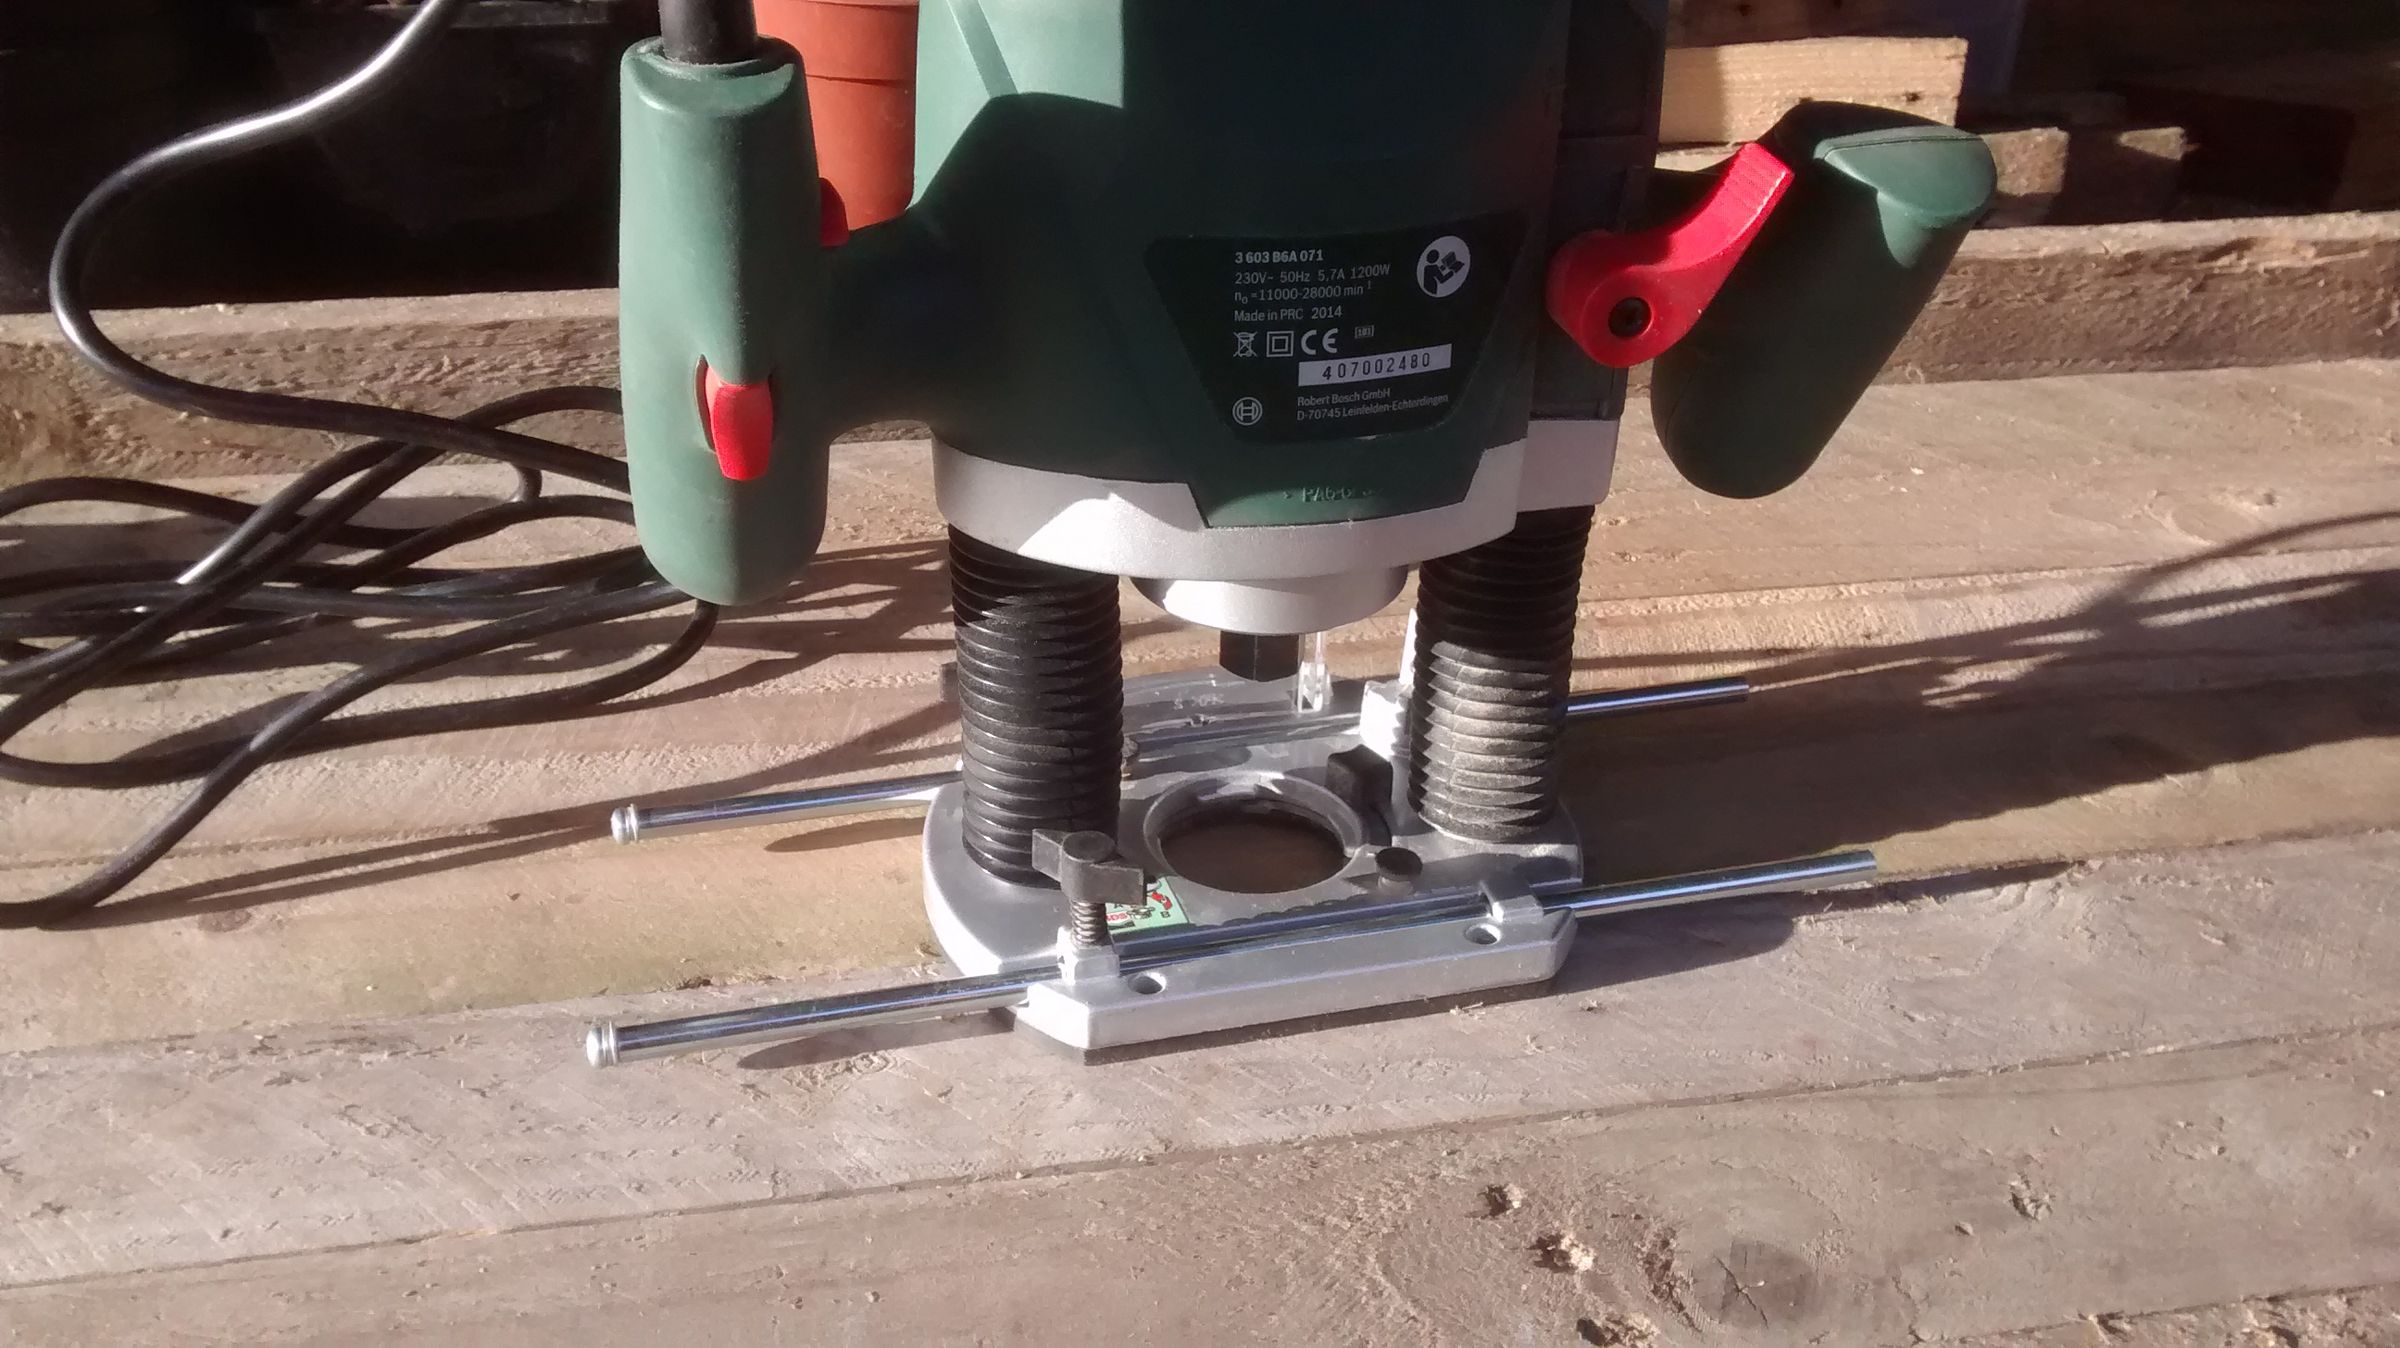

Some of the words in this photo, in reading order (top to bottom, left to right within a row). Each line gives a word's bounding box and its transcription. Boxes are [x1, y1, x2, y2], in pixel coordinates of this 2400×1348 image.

[1234, 251, 1243, 264] 3
[1245, 251, 1270, 264] 603
[1272, 250, 1297, 263] B6A
[1299, 249, 1324, 262] 071
[1279, 271, 1311, 284] 50Hz
[1350, 263, 1391, 280] 1200W
[1234, 308, 1266, 322] Made
[1267, 307, 1278, 321] in
[1280, 306, 1305, 321] PRC
[1311, 305, 1344, 320] 2014
[1300, 327, 1339, 356] CE
[1321, 352, 1431, 380] 407002480
[1296, 408, 1342, 421] D-70745
[1342, 393, 1449, 418] Leinfelden-Echterdingen
[1297, 393, 1331, 407] Robert
[1331, 391, 1361, 404] Bosch
[1361, 387, 1391, 401] GmbH
